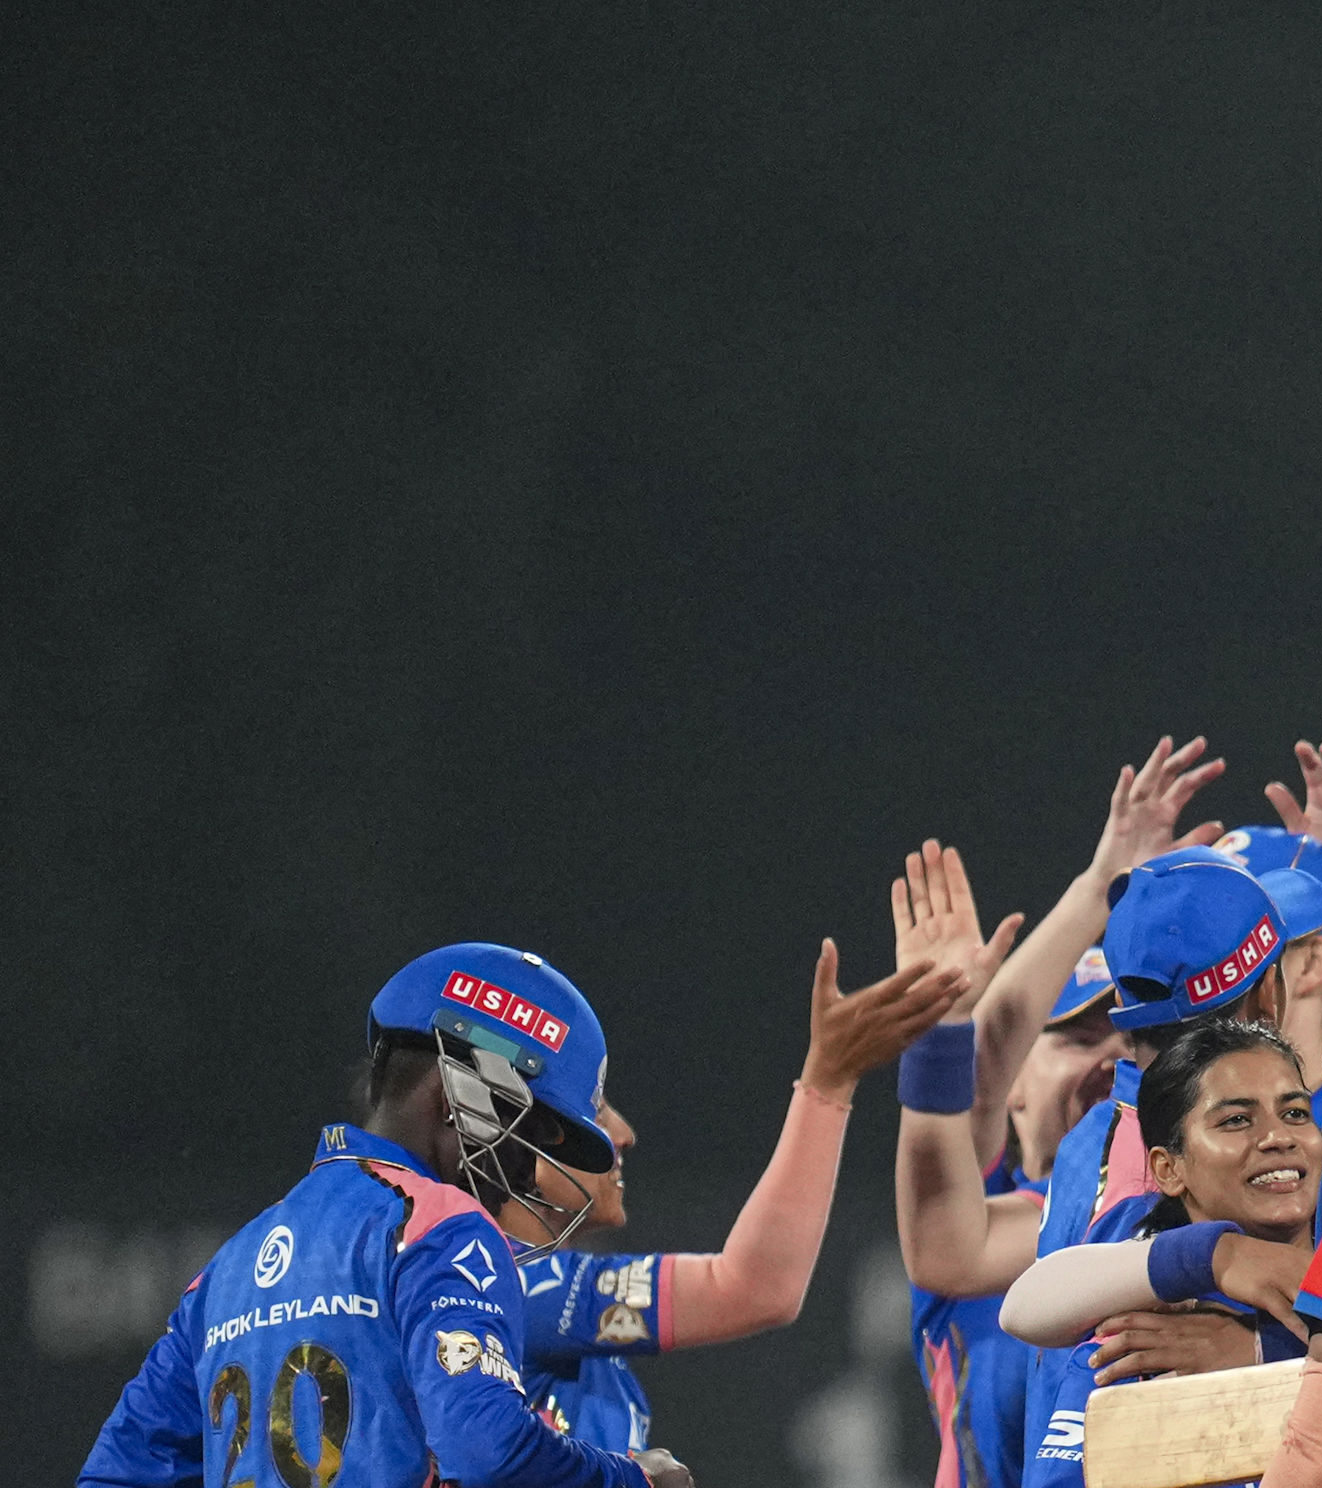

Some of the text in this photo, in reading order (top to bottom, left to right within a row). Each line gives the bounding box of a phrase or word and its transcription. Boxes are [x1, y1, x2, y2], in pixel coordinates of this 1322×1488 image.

[1194, 924, 1273, 997] USHA
[451, 976, 561, 1045] USHA
[323, 1126, 346, 1152] MI
[204, 1294, 379, 1352] SHOK LEYLAND
[431, 1296, 504, 1315] FOREVERM
